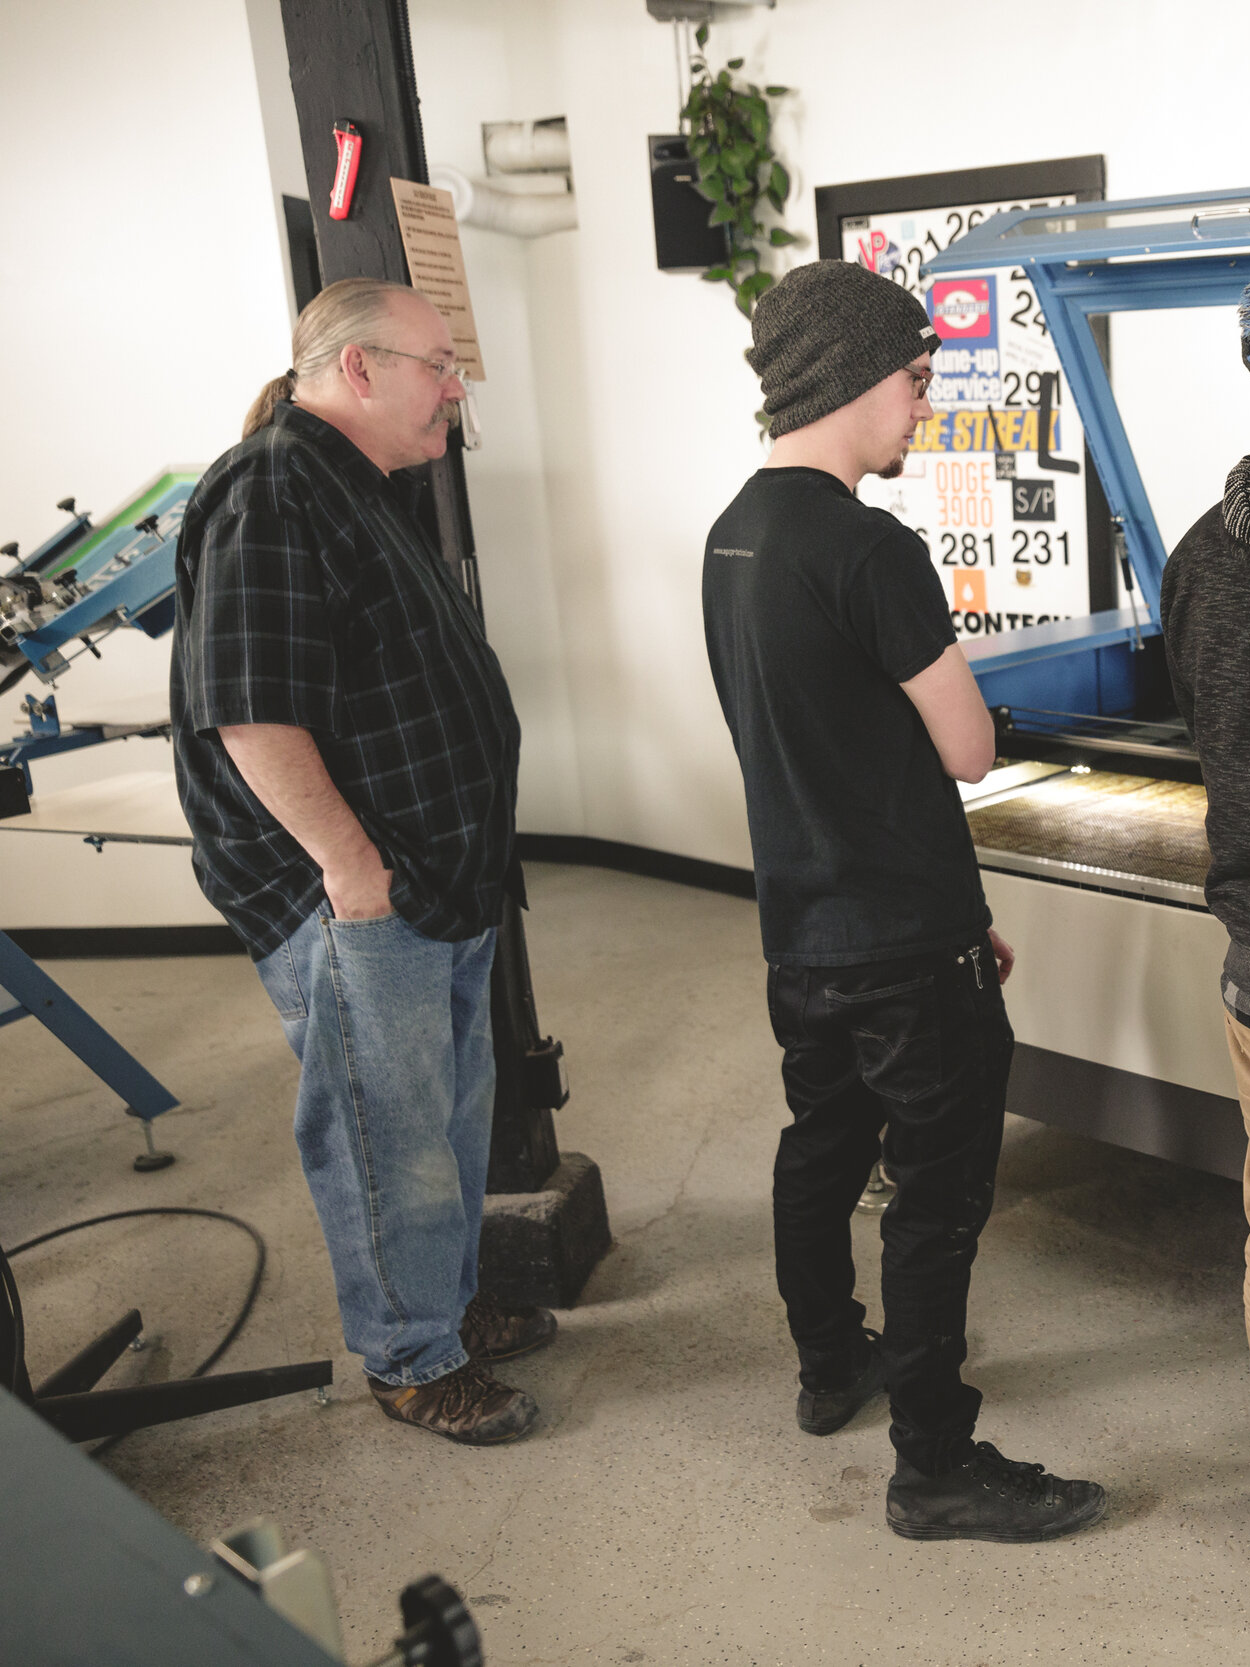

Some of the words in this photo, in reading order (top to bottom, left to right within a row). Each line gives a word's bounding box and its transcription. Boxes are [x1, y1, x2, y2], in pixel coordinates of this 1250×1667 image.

[930, 372, 1000, 401] Service
[1014, 486, 1056, 514] S/P
[941, 533, 995, 566] 281
[1012, 530, 1069, 566] 231
